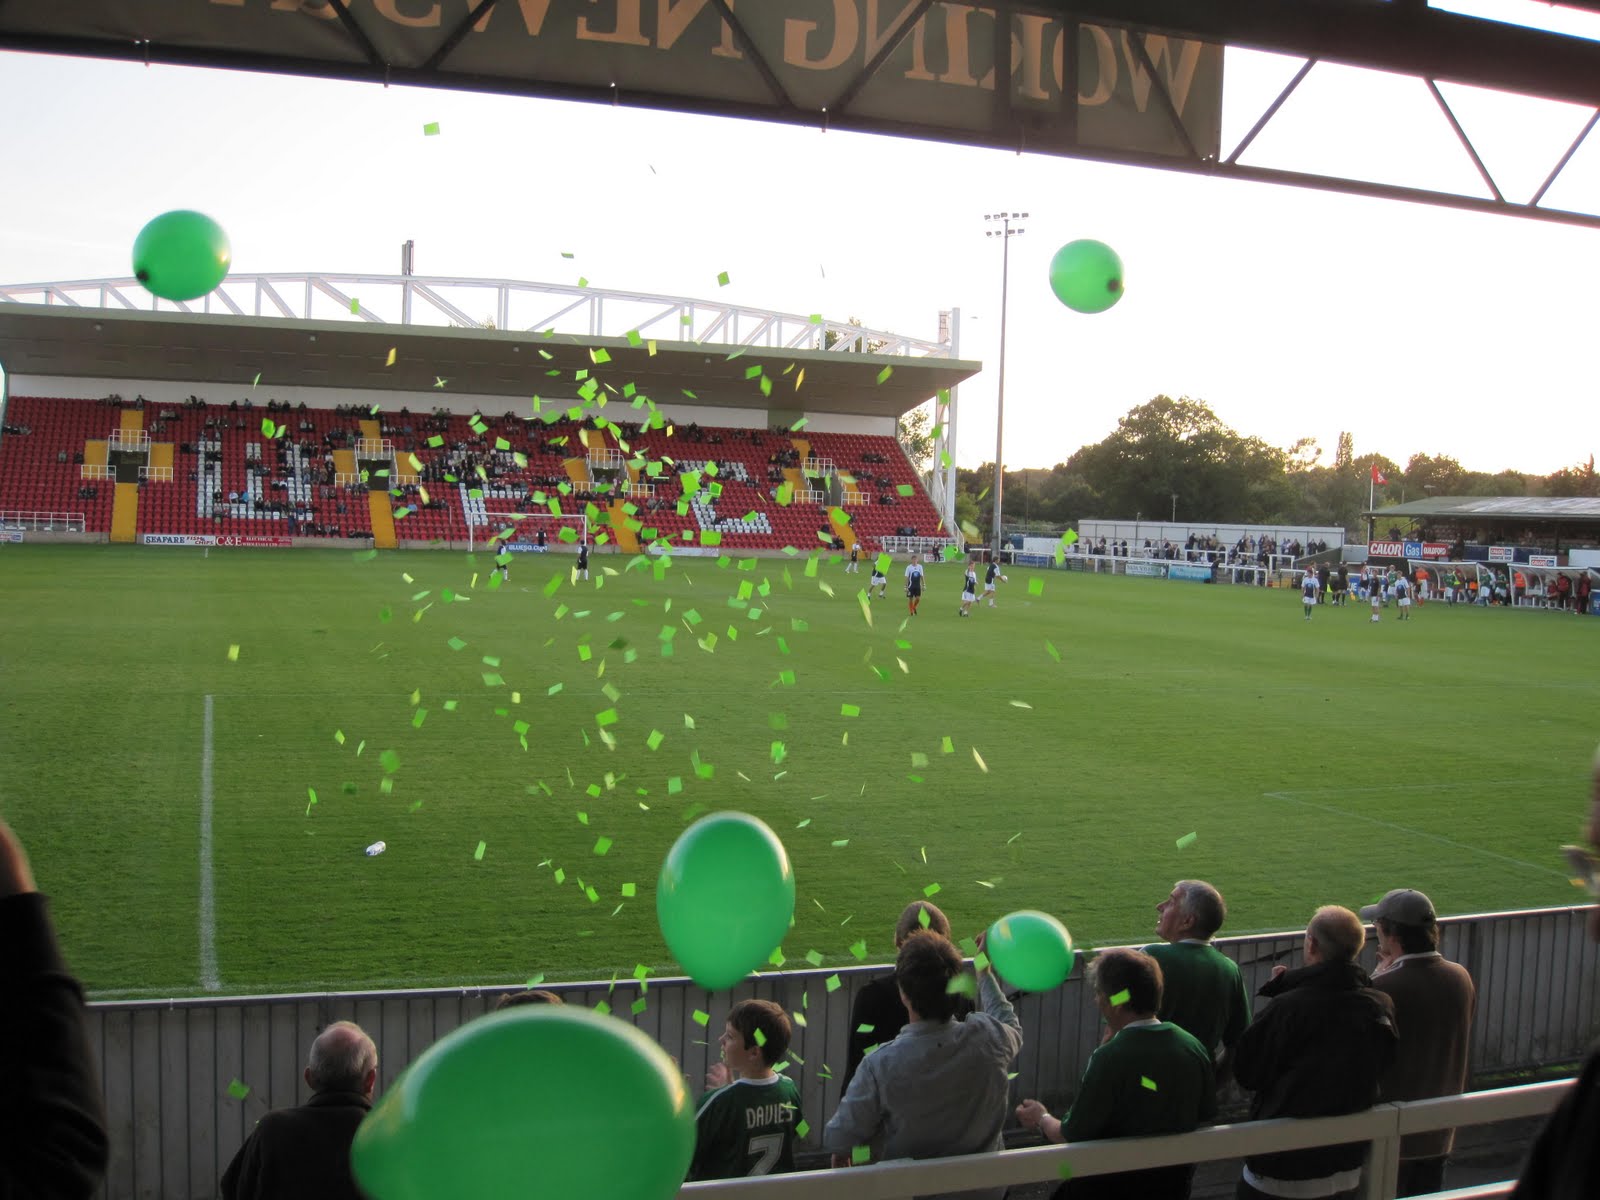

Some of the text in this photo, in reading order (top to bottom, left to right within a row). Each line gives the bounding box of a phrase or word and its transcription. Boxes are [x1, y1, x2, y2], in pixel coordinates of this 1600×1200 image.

[145, 535, 185, 544] SEAFARE
[1370, 543, 1402, 557] CALOR
[1405, 544, 1420, 557] Gas
[746, 1102, 793, 1129] DAVIES
[747, 1132, 785, 1177] 7
